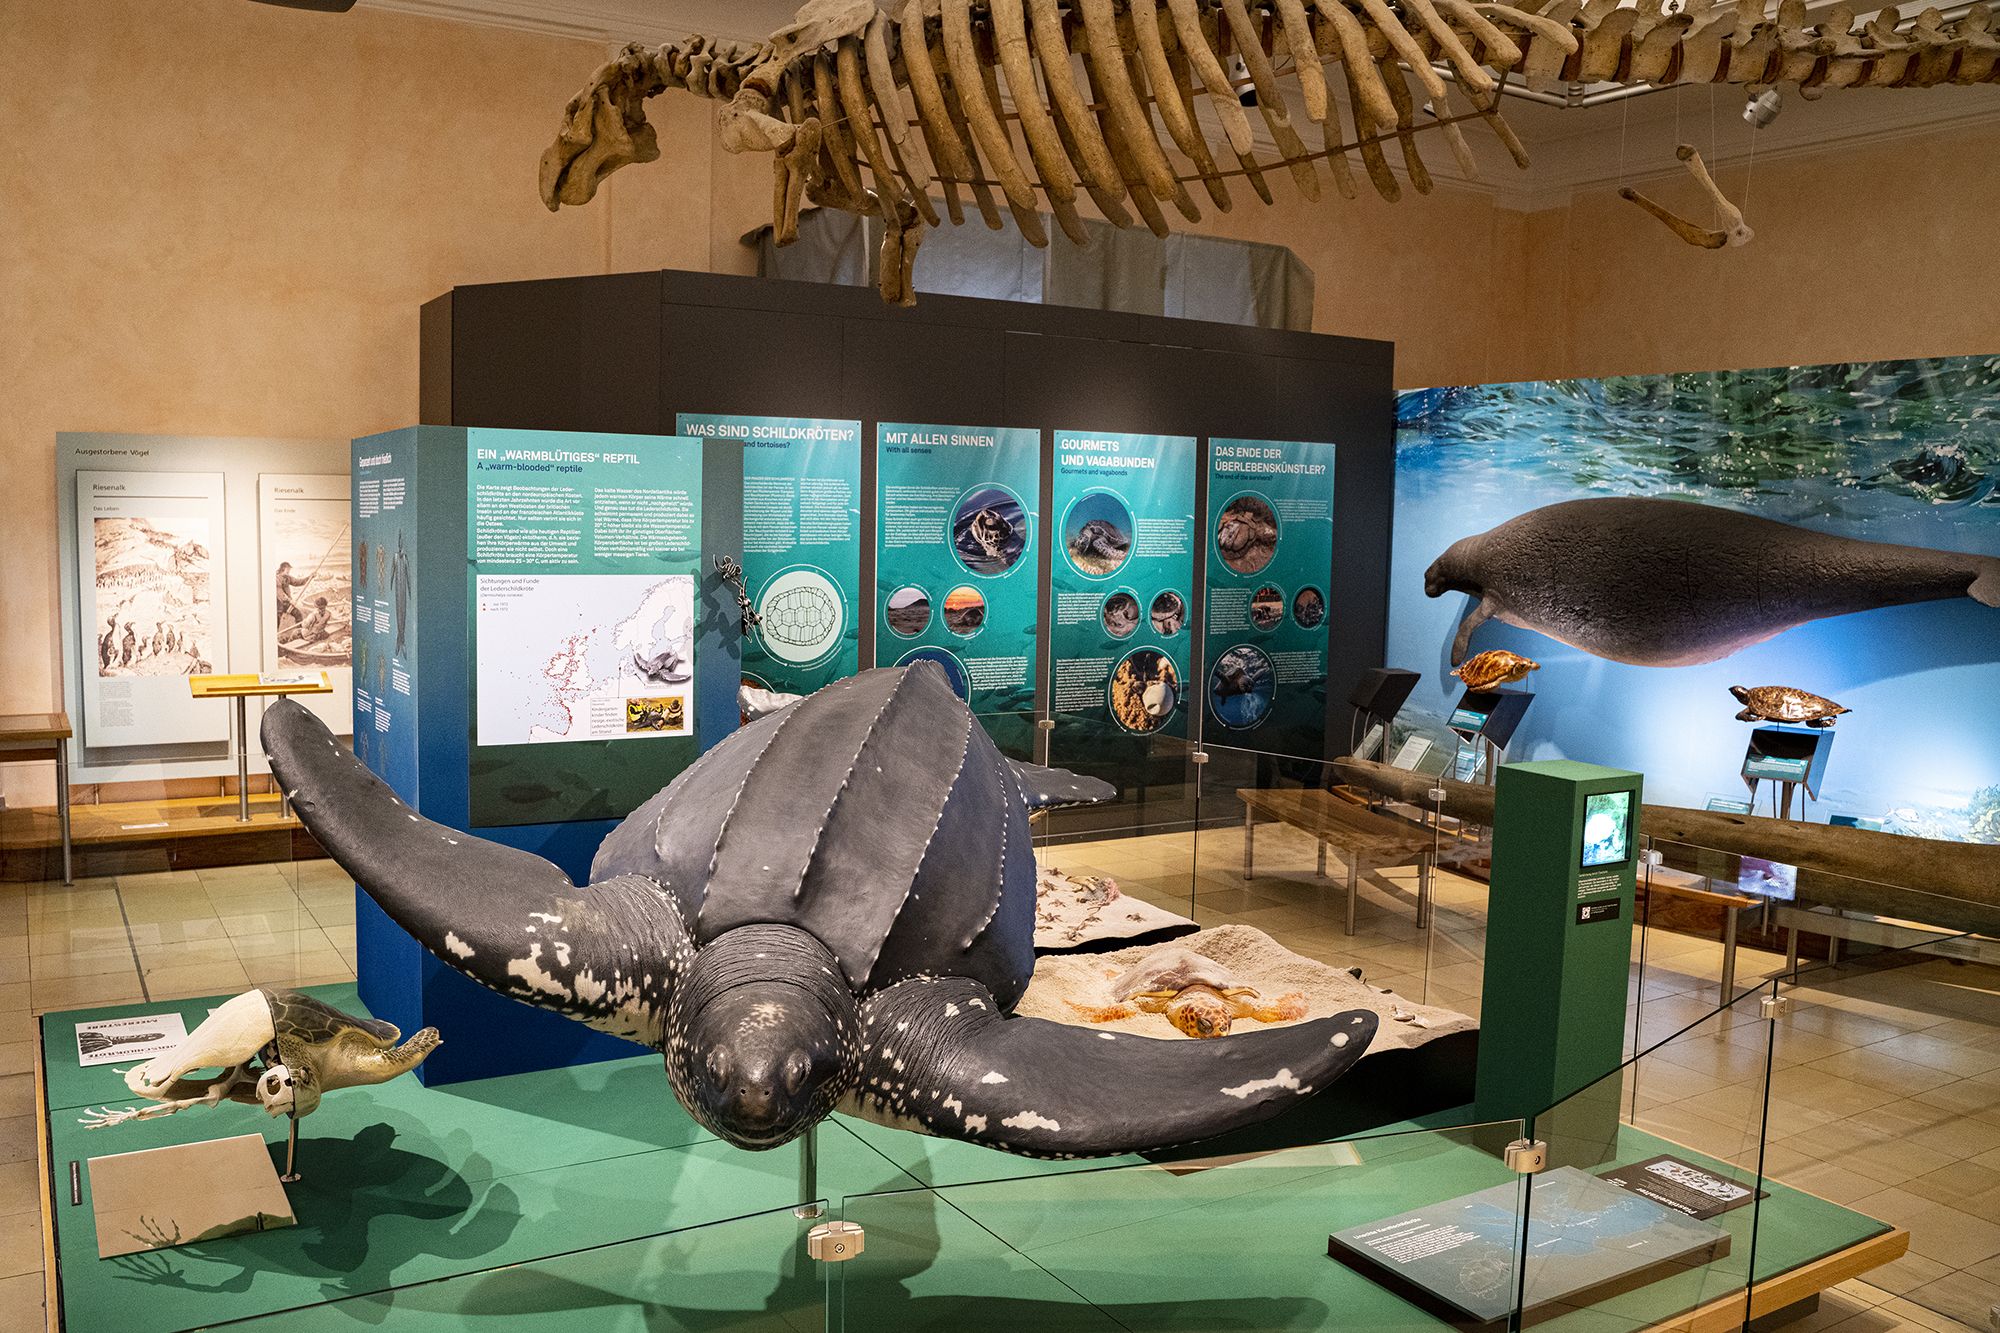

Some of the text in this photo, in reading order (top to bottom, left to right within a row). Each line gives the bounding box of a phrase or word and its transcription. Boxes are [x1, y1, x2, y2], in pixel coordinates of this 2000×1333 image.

[687, 424, 853, 441] WAS SIND SCHILDKRÖTEN?
[886, 433, 994, 447] MIT ALLEN SINNEN
[1061, 439, 1119, 451] GOURMETS
[75, 448, 128, 456] Ausgestorbene
[478, 449, 640, 464] EIN „WARMBLÜTIGES“ REPTIL
[1216, 446, 1281, 458] DAS ENDE DER
[485, 462, 554, 471] „warm-blooded“
[556, 465, 582, 473] reptile
[1061, 455, 1154, 468] UND VAGABUNDEN
[1216, 459, 1326, 475] ÜBERLEBENSKÜNSTLER?
